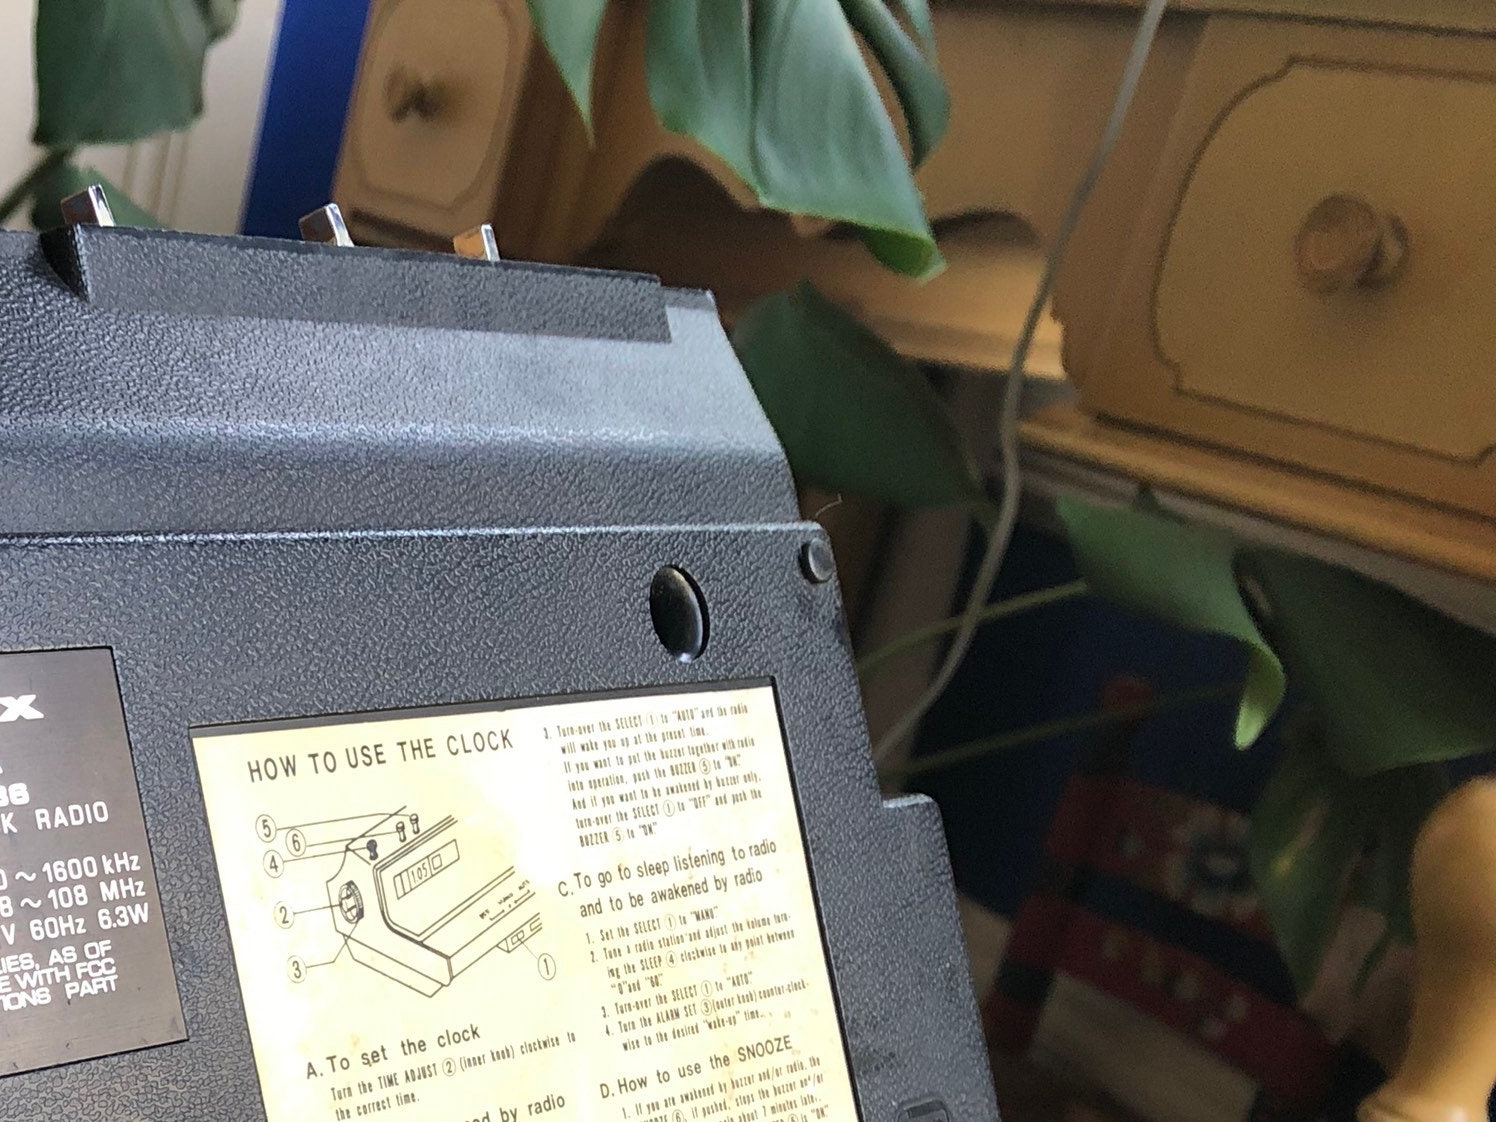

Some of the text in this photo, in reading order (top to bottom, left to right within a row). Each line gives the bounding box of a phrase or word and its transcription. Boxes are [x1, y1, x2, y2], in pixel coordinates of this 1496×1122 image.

[246, 728, 514, 783] HOW TO USE THE CLOCK
[34, 801, 109, 830] RADIO
[42, 856, 98, 883] 1600
[101, 851, 141, 874] kHz
[572, 871, 592, 889] To
[597, 870, 613, 889] go
[617, 863, 632, 881] to
[636, 860, 670, 879] sleep
[672, 848, 726, 872] listening
[730, 845, 746, 862] to
[748, 838, 777, 857] radio
[47, 884, 88, 909] 108
[99, 877, 146, 902] MHz
[579, 867, 763, 918] and to be awakened by radio
[29, 914, 86, 941] 60Hz
[97, 902, 148, 929] 6.3W
[49, 945, 77, 966] AS
[84, 939, 111, 959] OF
[14, 966, 71, 989] WITH
[75, 958, 117, 979] FCC
[64, 975, 118, 999] PART
[325, 1054, 351, 1073] To
[360, 1044, 389, 1067] set
[400, 1037, 427, 1057] the
[436, 1023, 481, 1049] clock
[330, 1086, 353, 1102] Turn
[357, 1080, 374, 1095] the
[377, 1072, 400, 1090] TIME
[404, 1062, 438, 1084] ADJUST
[459, 1053, 486, 1072] (inner
[489, 1044, 515, 1063] knob)
[519, 1034, 560, 1055] clockwise
[566, 1031, 576, 1044] to
[616, 1075, 648, 1095] How
[655, 1069, 671, 1085] to
[677, 1062, 702, 1079] use
[708, 1053, 731, 1070] the
[737, 1034, 794, 1063] SNOOZE
[335, 1092, 420, 1122] the correct time.
[527, 1093, 566, 1117] radio
